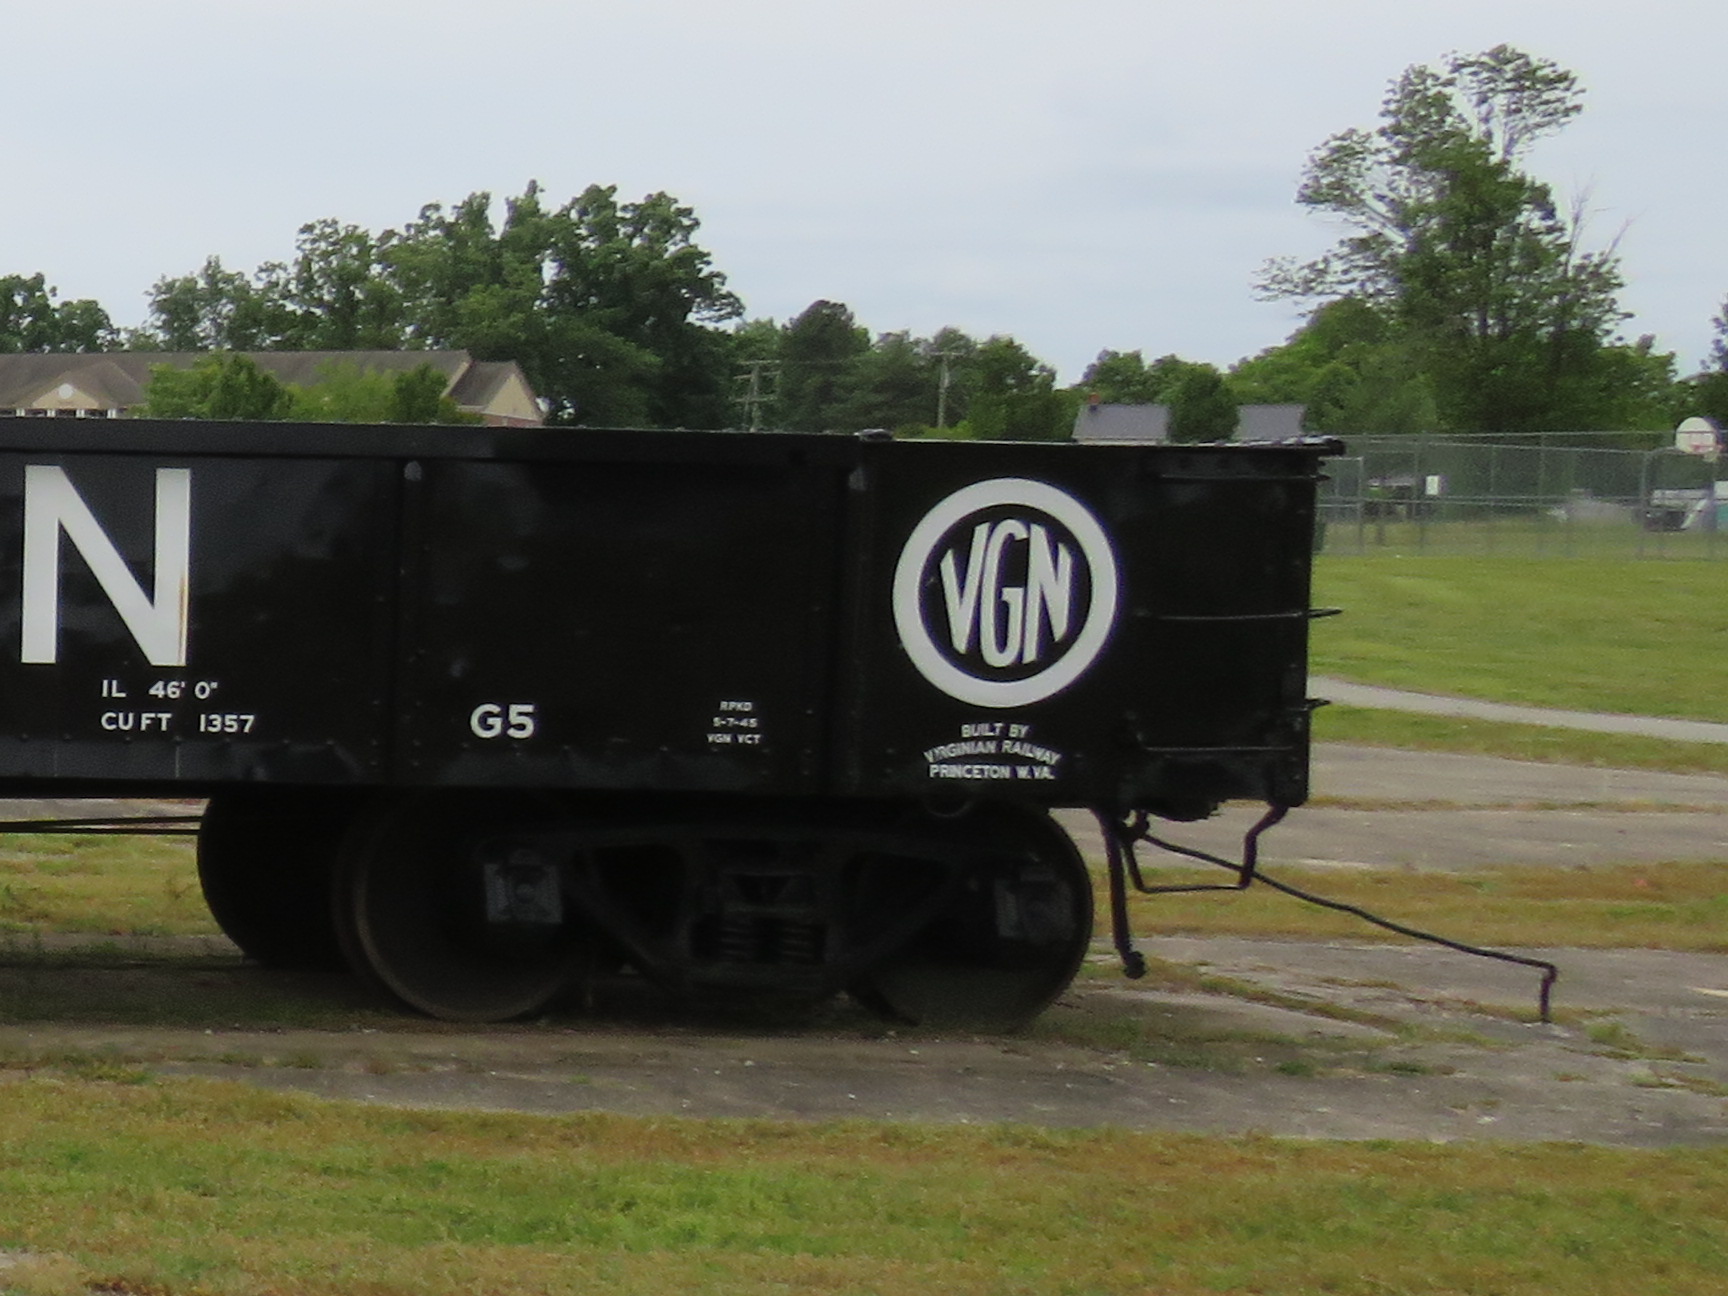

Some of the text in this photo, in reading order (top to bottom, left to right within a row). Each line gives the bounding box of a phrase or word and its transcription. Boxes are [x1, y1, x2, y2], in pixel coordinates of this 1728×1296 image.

[939, 518, 1074, 669] VGN
[101, 679, 127, 698] IL
[199, 713, 255, 733] 1357
[470, 703, 535, 739] G5
[961, 722, 1029, 738] BUILT BY
[923, 739, 1061, 765] VIRGINIAN RAILWAY
[929, 765, 1011, 779] PRINCETON
